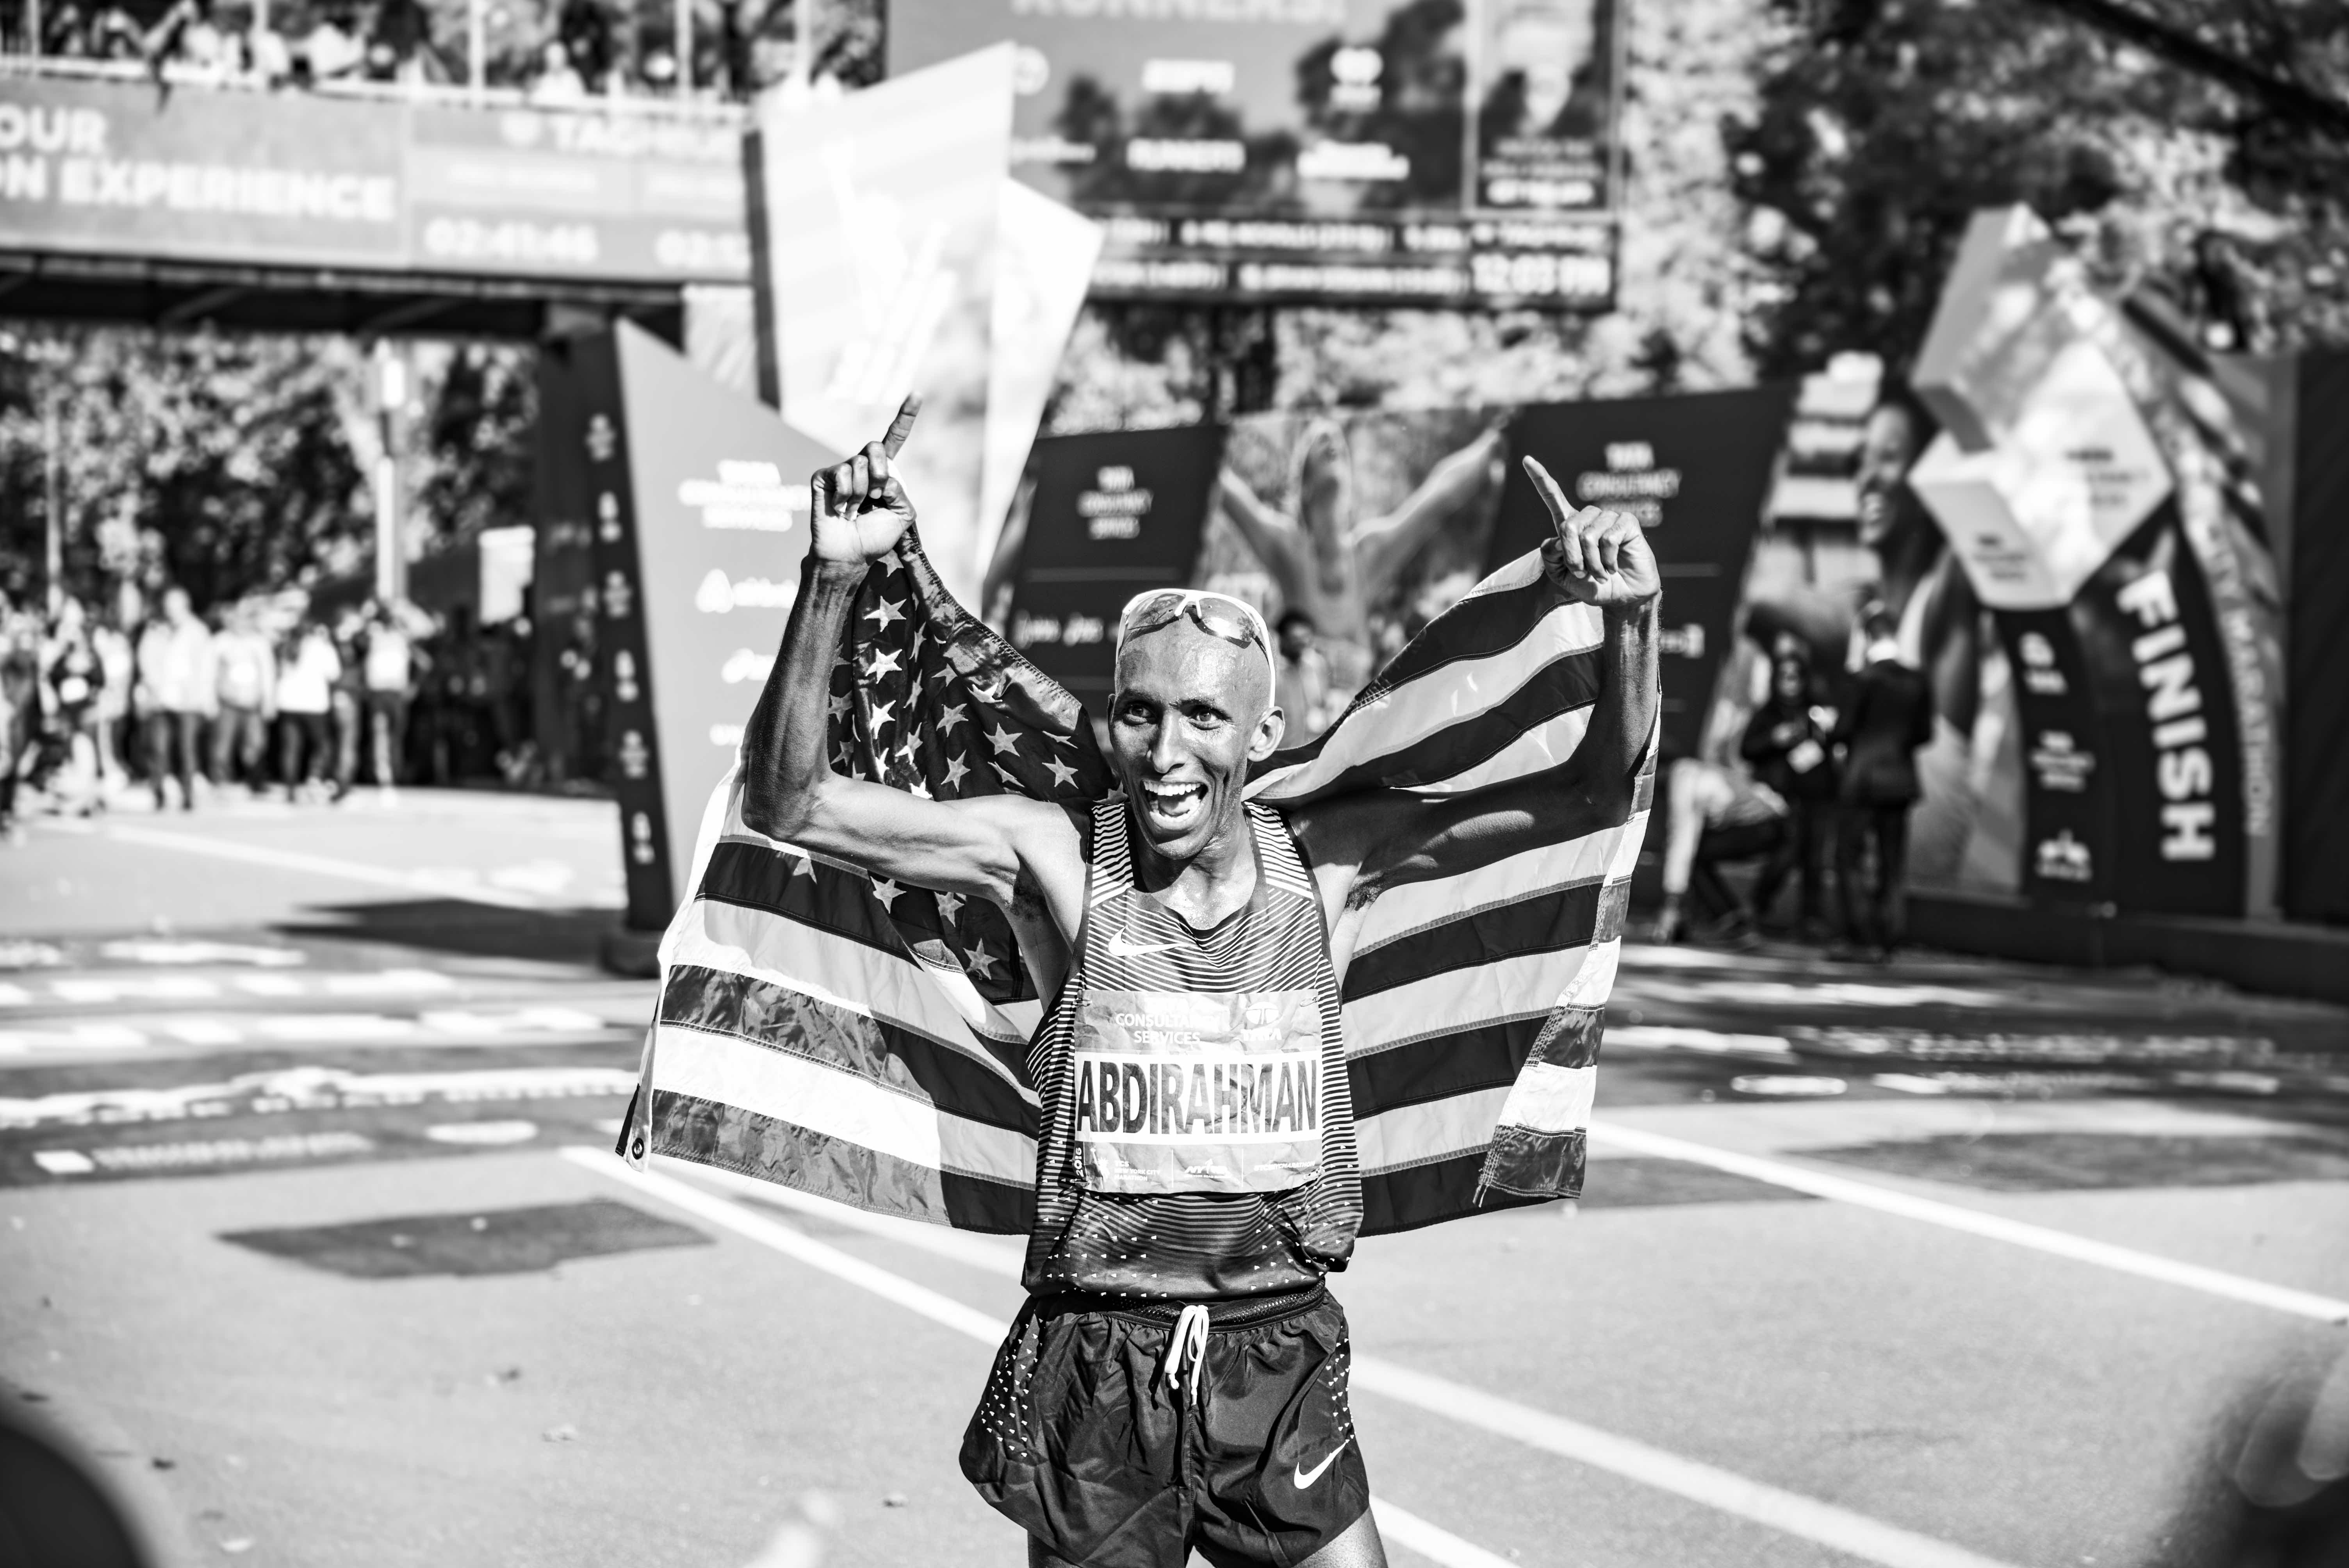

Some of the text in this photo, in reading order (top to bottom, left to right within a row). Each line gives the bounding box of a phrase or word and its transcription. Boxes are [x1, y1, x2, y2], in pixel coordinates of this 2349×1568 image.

[0, 156, 46, 201] N
[61, 159, 394, 221] EXPERIENCE
[2117, 570, 2215, 859] FINISH
[1116, 1014, 1219, 1031] CONSULTA
[1134, 1031, 1200, 1044] SERVICES
[1076, 1060, 1317, 1134] ABDIRAHMAN
[1074, 1147, 1084, 1177] 2016
